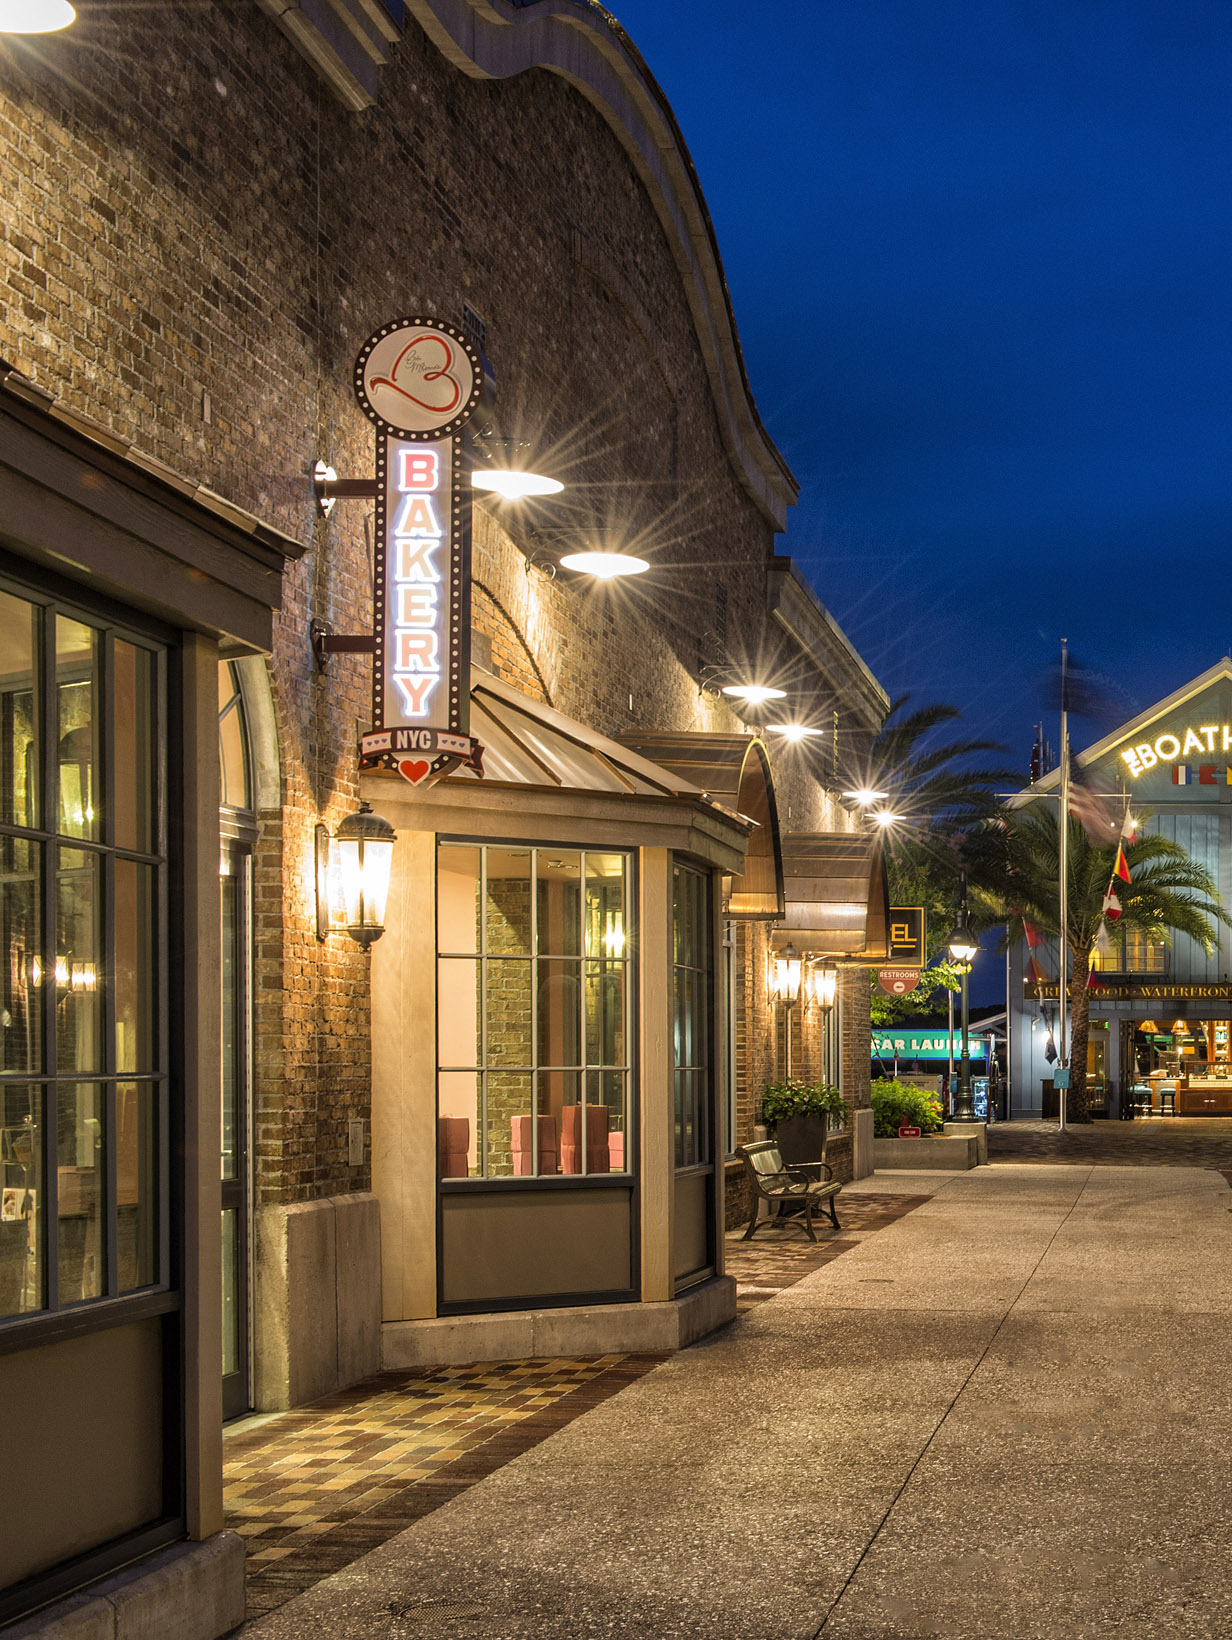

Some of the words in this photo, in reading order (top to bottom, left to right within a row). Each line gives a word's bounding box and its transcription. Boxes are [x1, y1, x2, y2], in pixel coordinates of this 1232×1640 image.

[395, 449, 441, 717] BAKERY
[396, 729, 432, 750] NYC
[879, 971, 919, 979] RESTROOMS
[1088, 986, 1129, 997] FOOD
[871, 1039, 905, 1050] CAR
